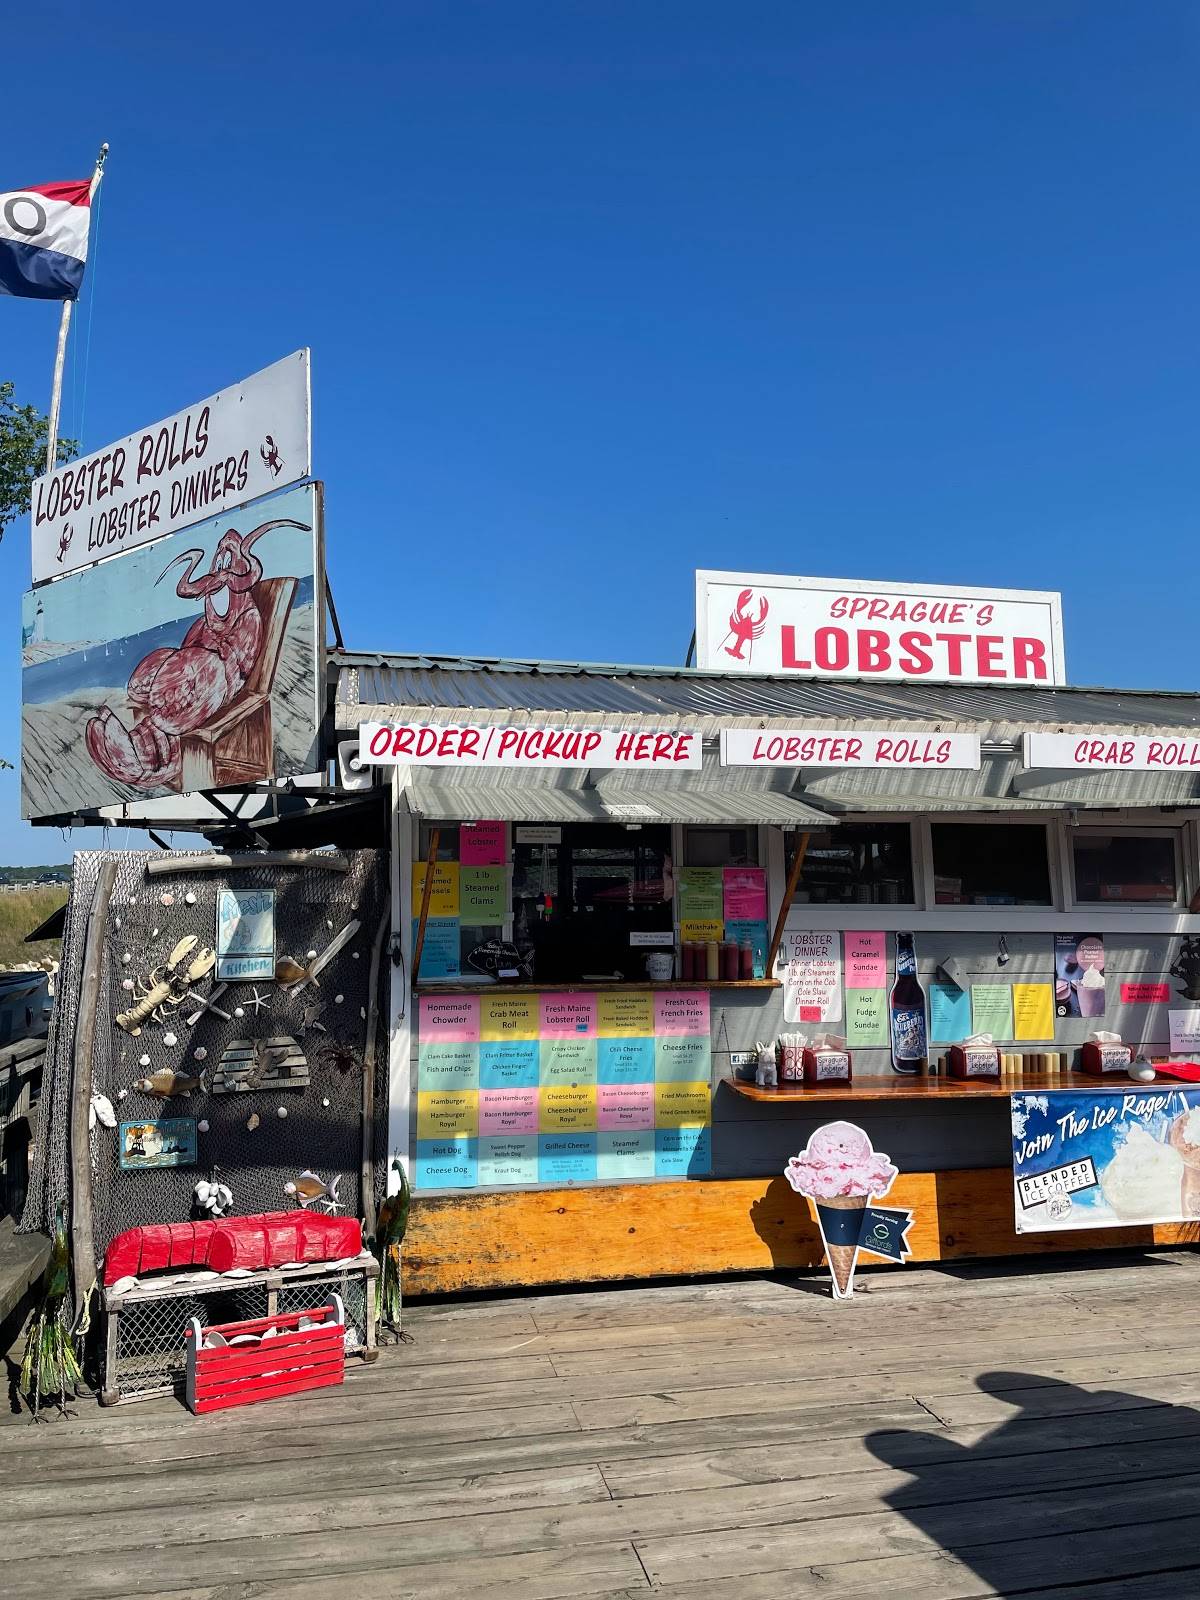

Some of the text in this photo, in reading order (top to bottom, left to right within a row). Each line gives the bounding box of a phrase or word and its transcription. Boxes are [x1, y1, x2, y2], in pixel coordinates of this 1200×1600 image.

[35, 405, 211, 526] LOBSTER ROLLS
[87, 449, 250, 552] LOBSTER DINNERS
[829, 596, 996, 627] SPRAGUE'S
[780, 624, 1048, 680] LOBSTER
[369, 726, 694, 762] ORDER/PICKUP HERE
[752, 736, 952, 764] LOBSTER ROLLS
[1074, 739, 1136, 764] CRAB
[465, 825, 500, 833] Steamed
[468, 838, 499, 846] Lobster
[465, 884, 500, 892] Steamed
[470, 897, 494, 906] Clams
[686, 923, 718, 931] Milkshake
[790, 934, 833, 945] LOBSTER
[794, 946, 829, 957] DINNER
[791, 958, 836, 967] Dinner Lobster
[226, 960, 270, 976] Kitchen
[788, 978, 804, 986] Corn
[814, 978, 823, 986] the
[824, 978, 836, 986] Cob
[798, 987, 827, 996] Cole Slaw
[796, 997, 830, 1006] Dinner Roll
[427, 1003, 472, 1012] Homemade
[546, 1004, 566, 1012] Fresh
[490, 1010, 507, 1018] Crab
[856, 1009, 877, 1017] Fudge
[432, 1016, 467, 1024] Chowder
[502, 1021, 517, 1029] Roll
[818, 1056, 848, 1065] Sprague's
[968, 1052, 996, 1062] Sprague's
[548, 1092, 588, 1100] Cheeseburger
[440, 1120, 456, 1128] Royal
[1015, 1091, 1173, 1165] Join The Ice Rage!
[448, 1146, 462, 1155] Dog
[1024, 1162, 1088, 1192] BLENDED
[1025, 1172, 1091, 1202] ICE COFFEE
